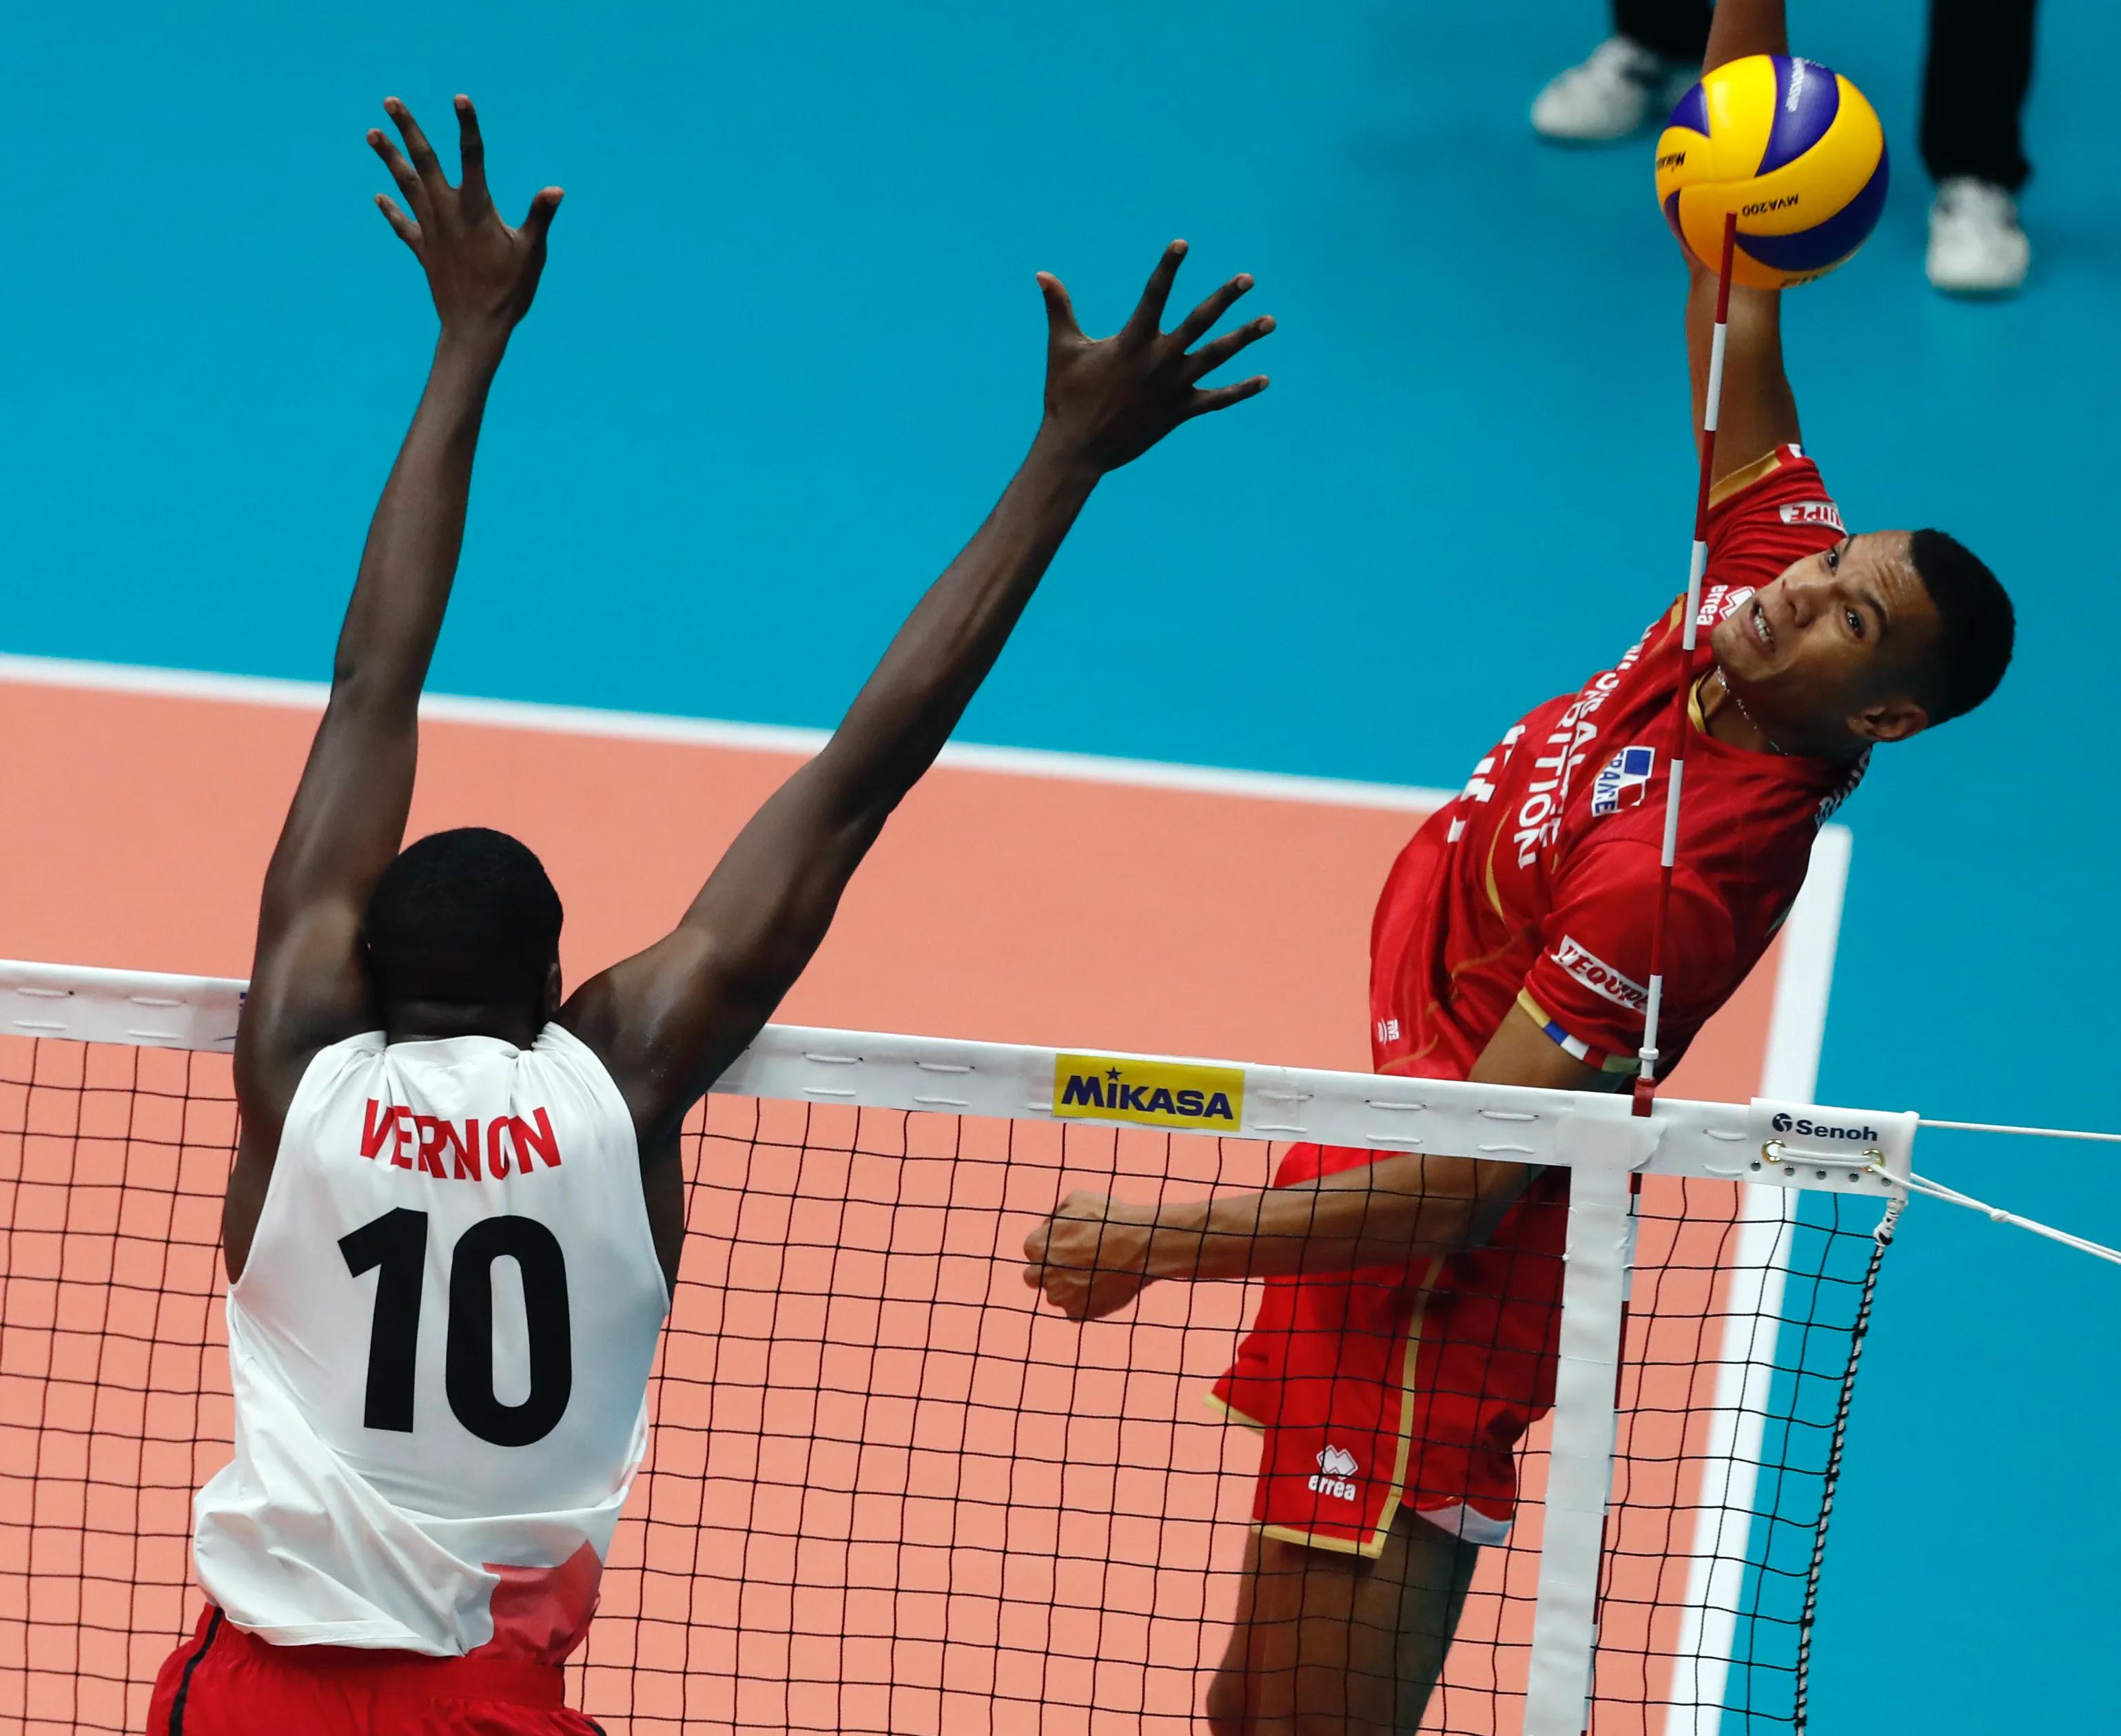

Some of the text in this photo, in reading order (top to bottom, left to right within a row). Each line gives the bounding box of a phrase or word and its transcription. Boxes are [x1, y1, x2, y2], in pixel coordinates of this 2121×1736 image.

[1741, 193, 1799, 216] MVA200
[1696, 584, 1728, 626] errea
[1061, 1066, 1233, 1119] MIKASA
[360, 1097, 562, 1182] VERNON
[1796, 1119, 1878, 1141] Senoh
[337, 1207, 572, 1447] 10
[1308, 1475, 1357, 1501] errea
